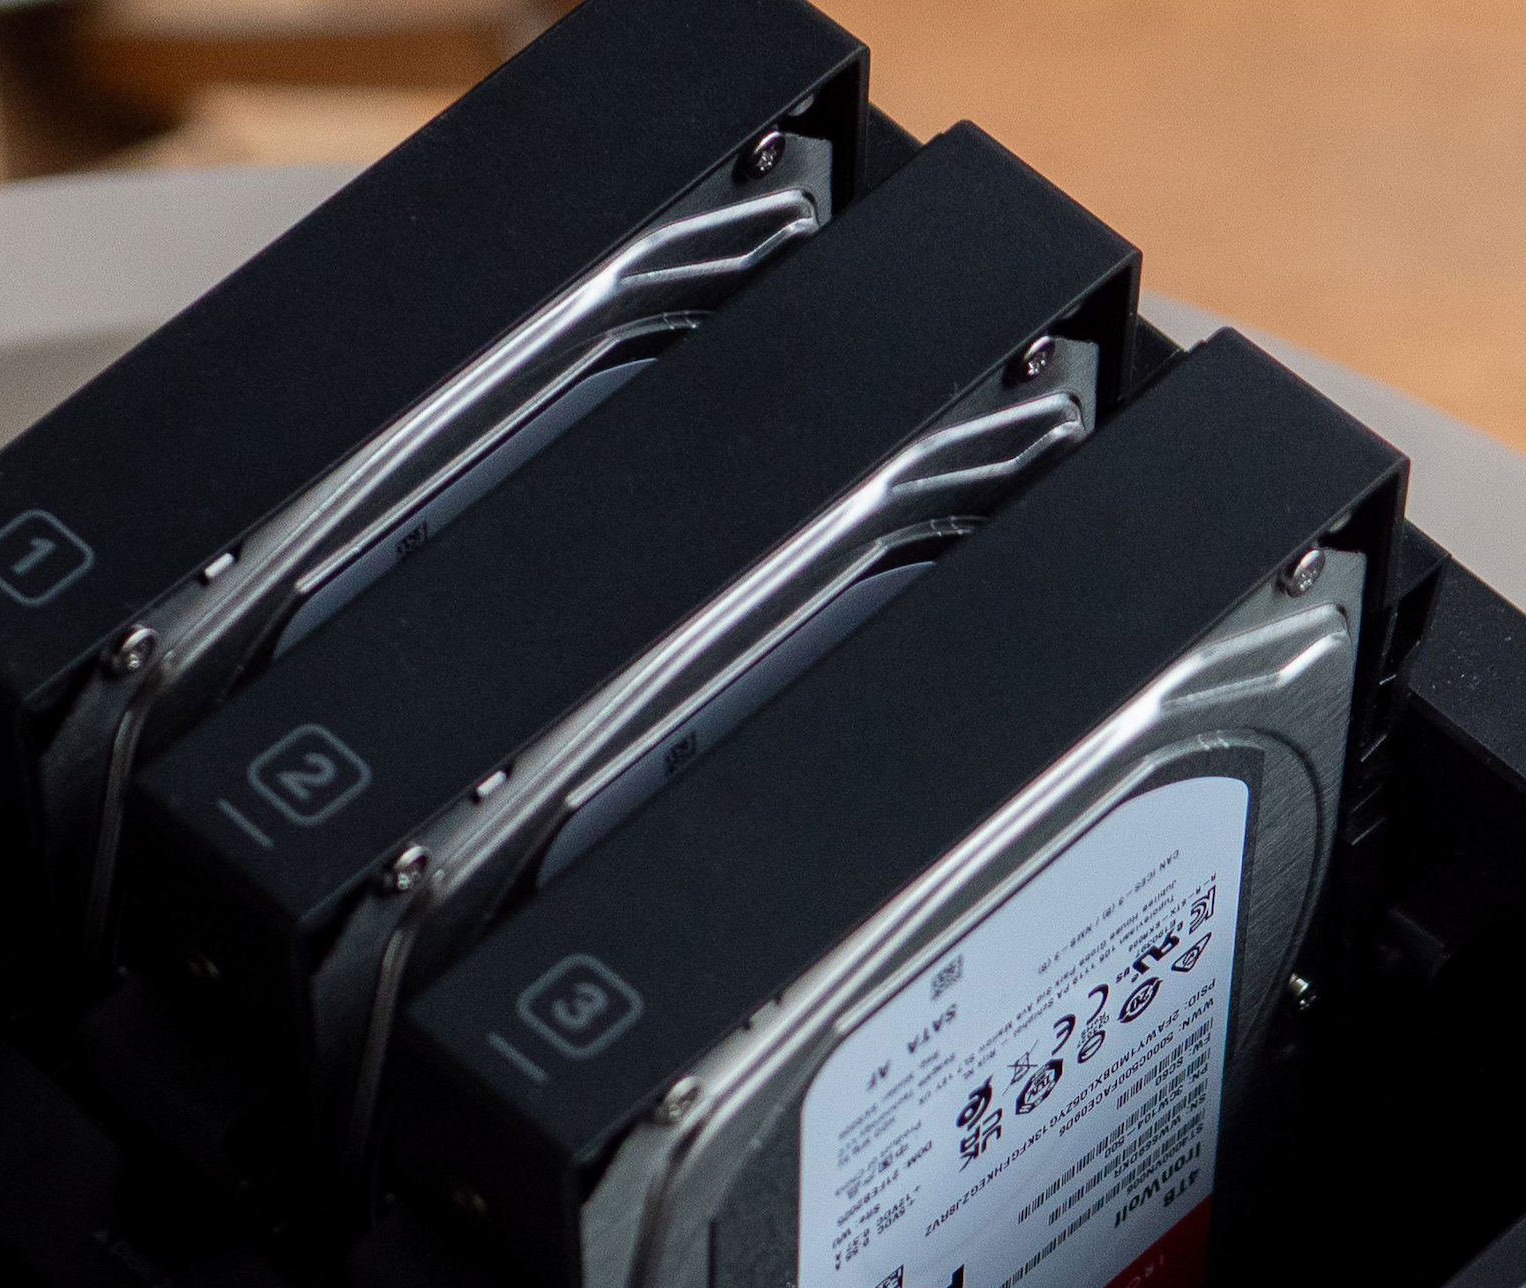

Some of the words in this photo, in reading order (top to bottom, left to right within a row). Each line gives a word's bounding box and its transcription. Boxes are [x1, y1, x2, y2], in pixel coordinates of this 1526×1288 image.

[12, 536, 56, 577] 1
[276, 752, 337, 800] 2
[552, 981, 608, 1029] 3
[1177, 994, 1214, 1035] WWN:
[1183, 976, 1215, 1013] PSID:
[905, 999, 957, 1060] SATA
[1113, 1138, 1201, 1230] IronWolf
[1162, 1164, 1199, 1210] 4TB
